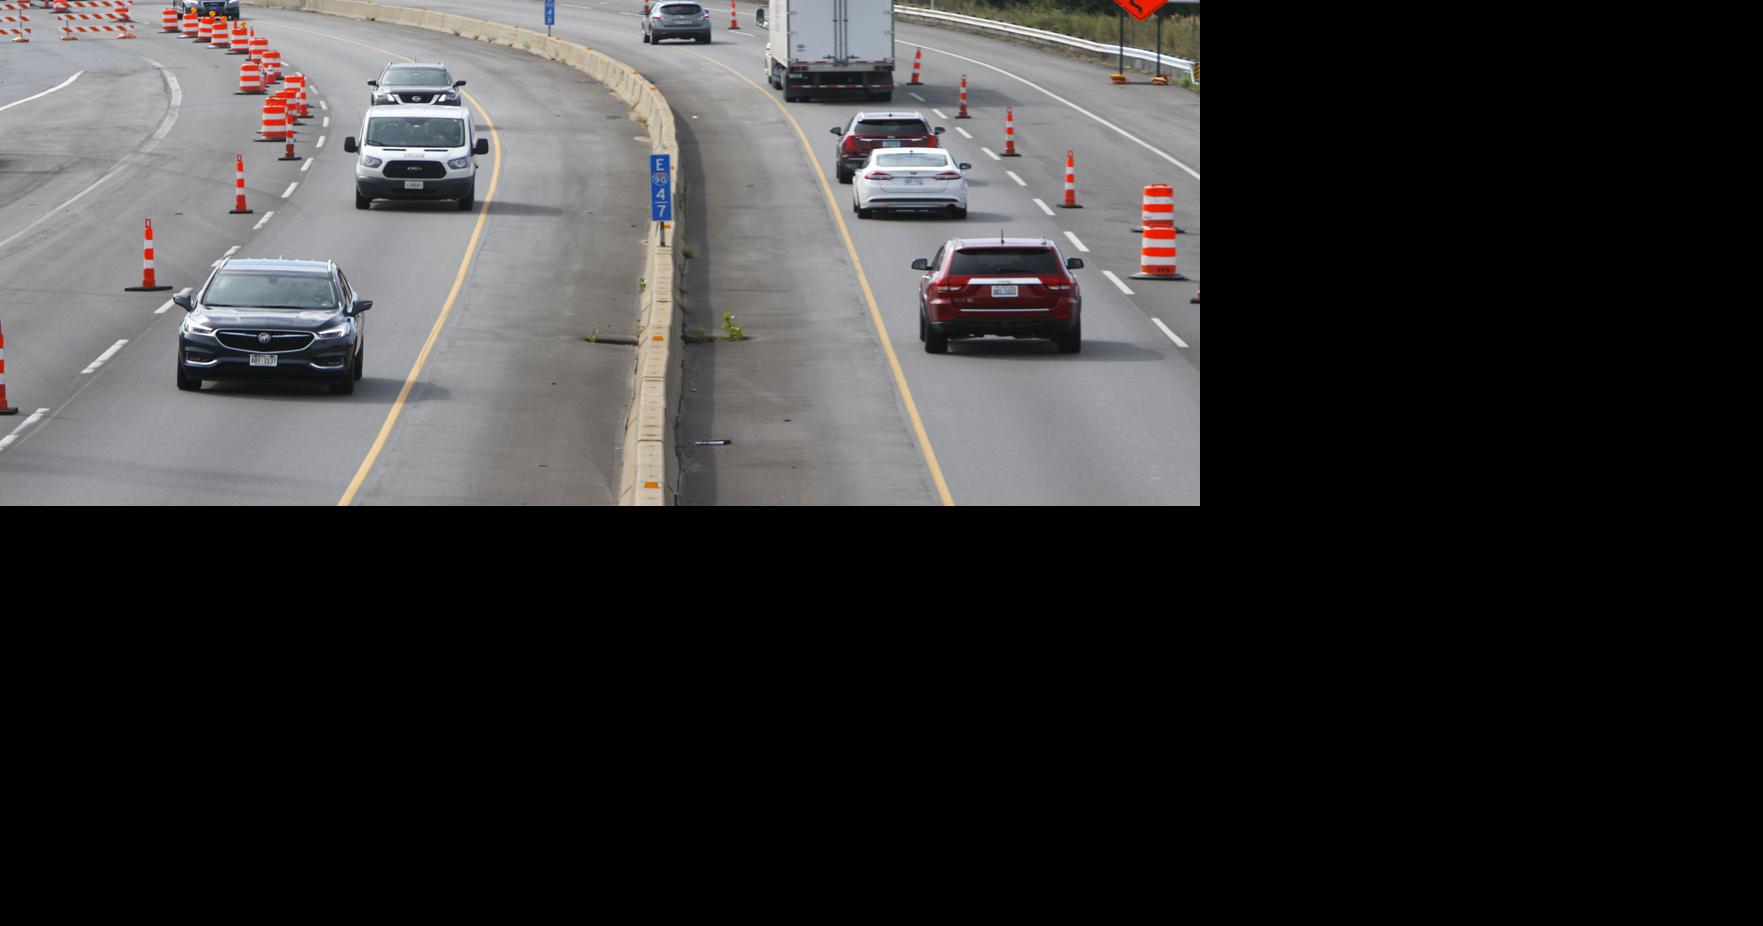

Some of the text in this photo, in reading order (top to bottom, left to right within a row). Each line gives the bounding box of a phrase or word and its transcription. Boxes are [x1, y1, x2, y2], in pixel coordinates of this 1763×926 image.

[656, 158, 665, 171] E
[655, 176, 667, 184] 90
[656, 188, 666, 201] 4
[657, 204, 666, 218] 7
